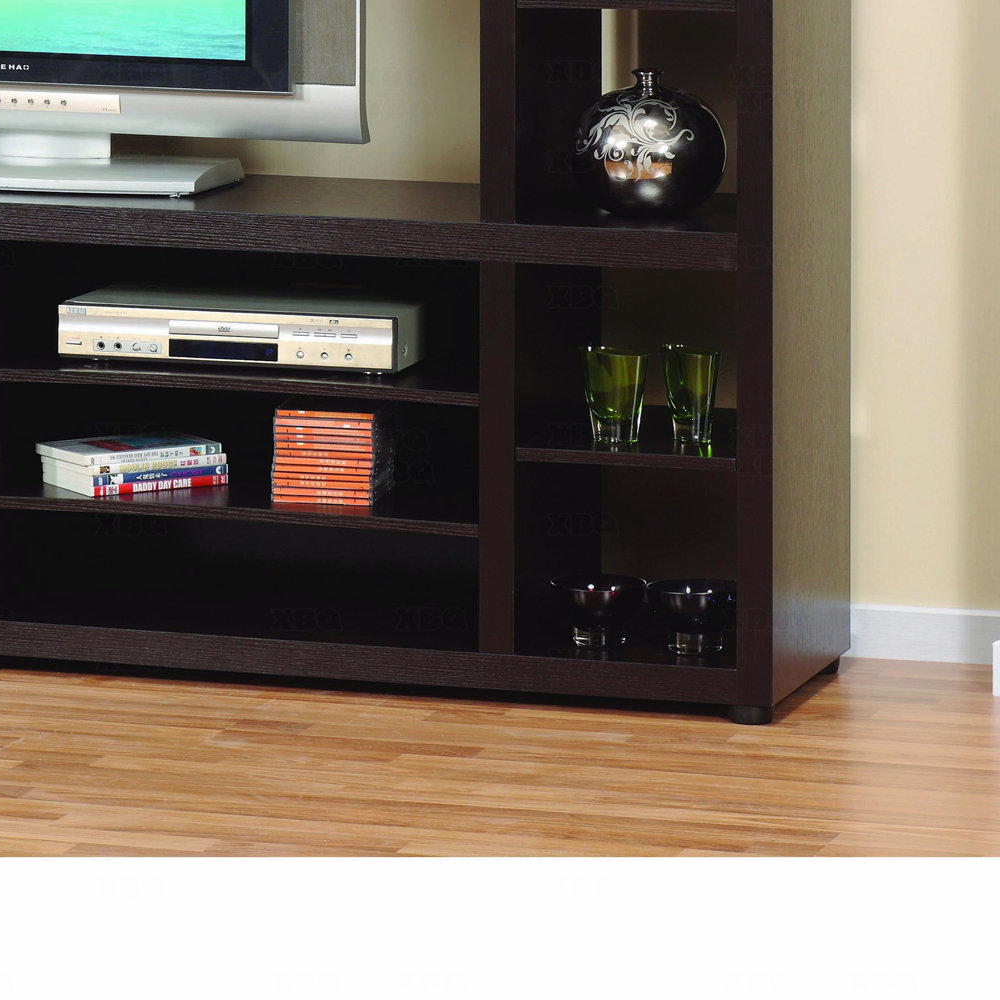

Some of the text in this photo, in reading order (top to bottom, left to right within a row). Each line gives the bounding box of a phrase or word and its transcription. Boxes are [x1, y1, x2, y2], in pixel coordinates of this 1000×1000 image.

[132, 478, 192, 492] DADDY DAY CARE
